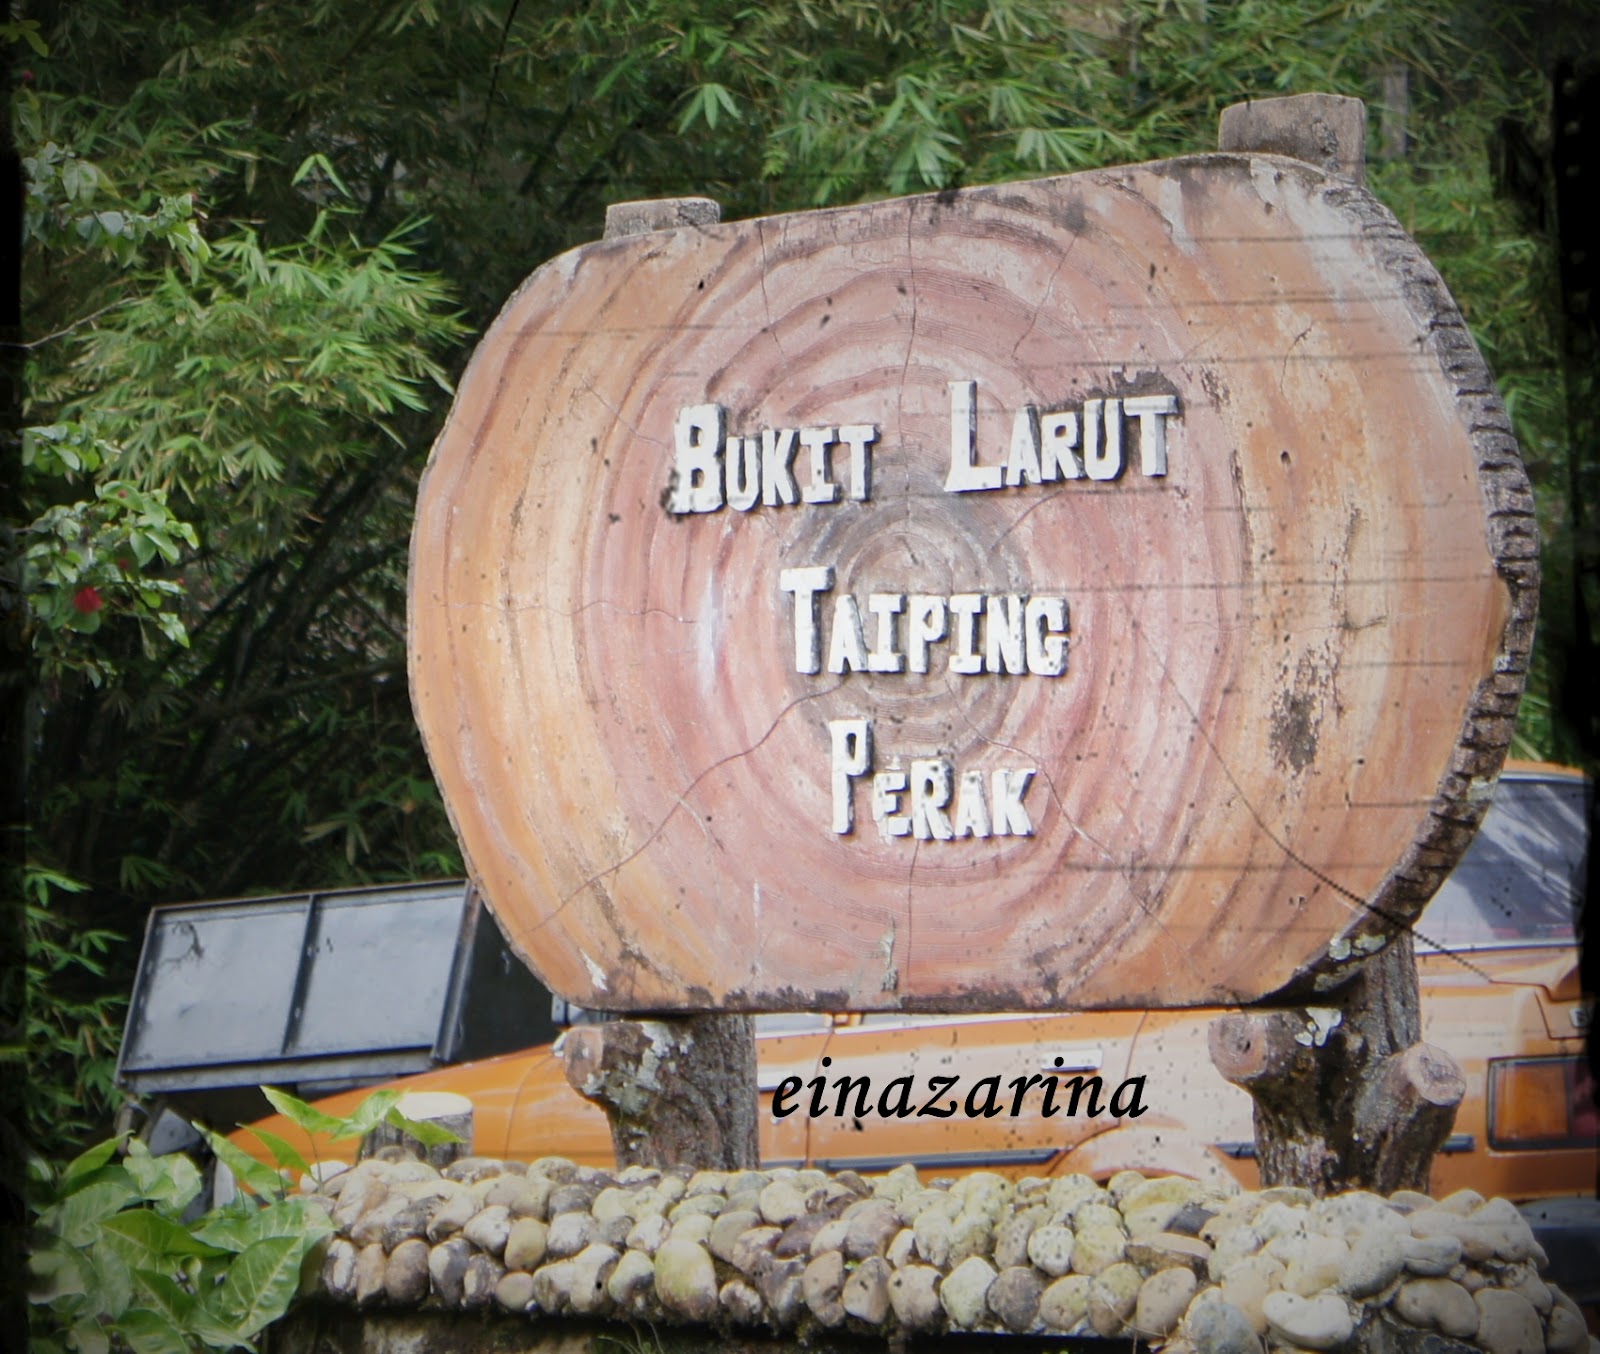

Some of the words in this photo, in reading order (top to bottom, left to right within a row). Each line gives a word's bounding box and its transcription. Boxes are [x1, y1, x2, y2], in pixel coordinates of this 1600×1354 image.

[668, 402, 880, 515] BUKIT
[944, 379, 1182, 493] LARUT
[779, 565, 1071, 678] TAIPING
